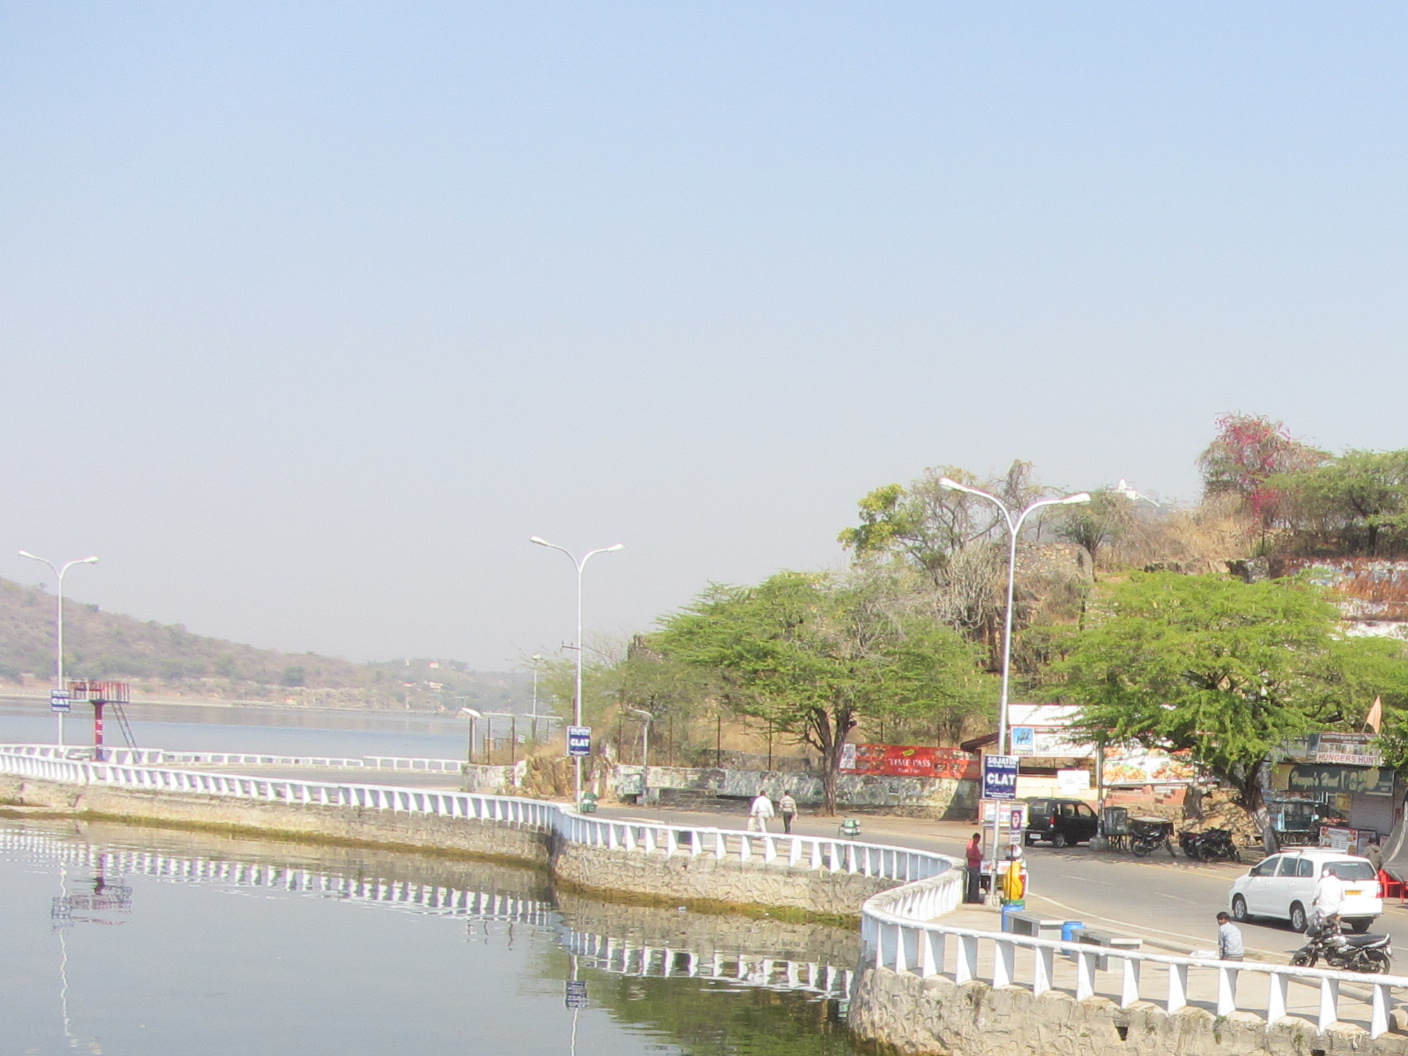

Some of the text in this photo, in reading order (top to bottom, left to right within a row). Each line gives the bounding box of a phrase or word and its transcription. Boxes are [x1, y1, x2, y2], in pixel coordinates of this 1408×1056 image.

[570, 738, 589, 747] CLAT
[1318, 752, 1357, 763] HUNGERS
[888, 758, 931, 768] TIME PASS
[986, 773, 1016, 786] CLAT
